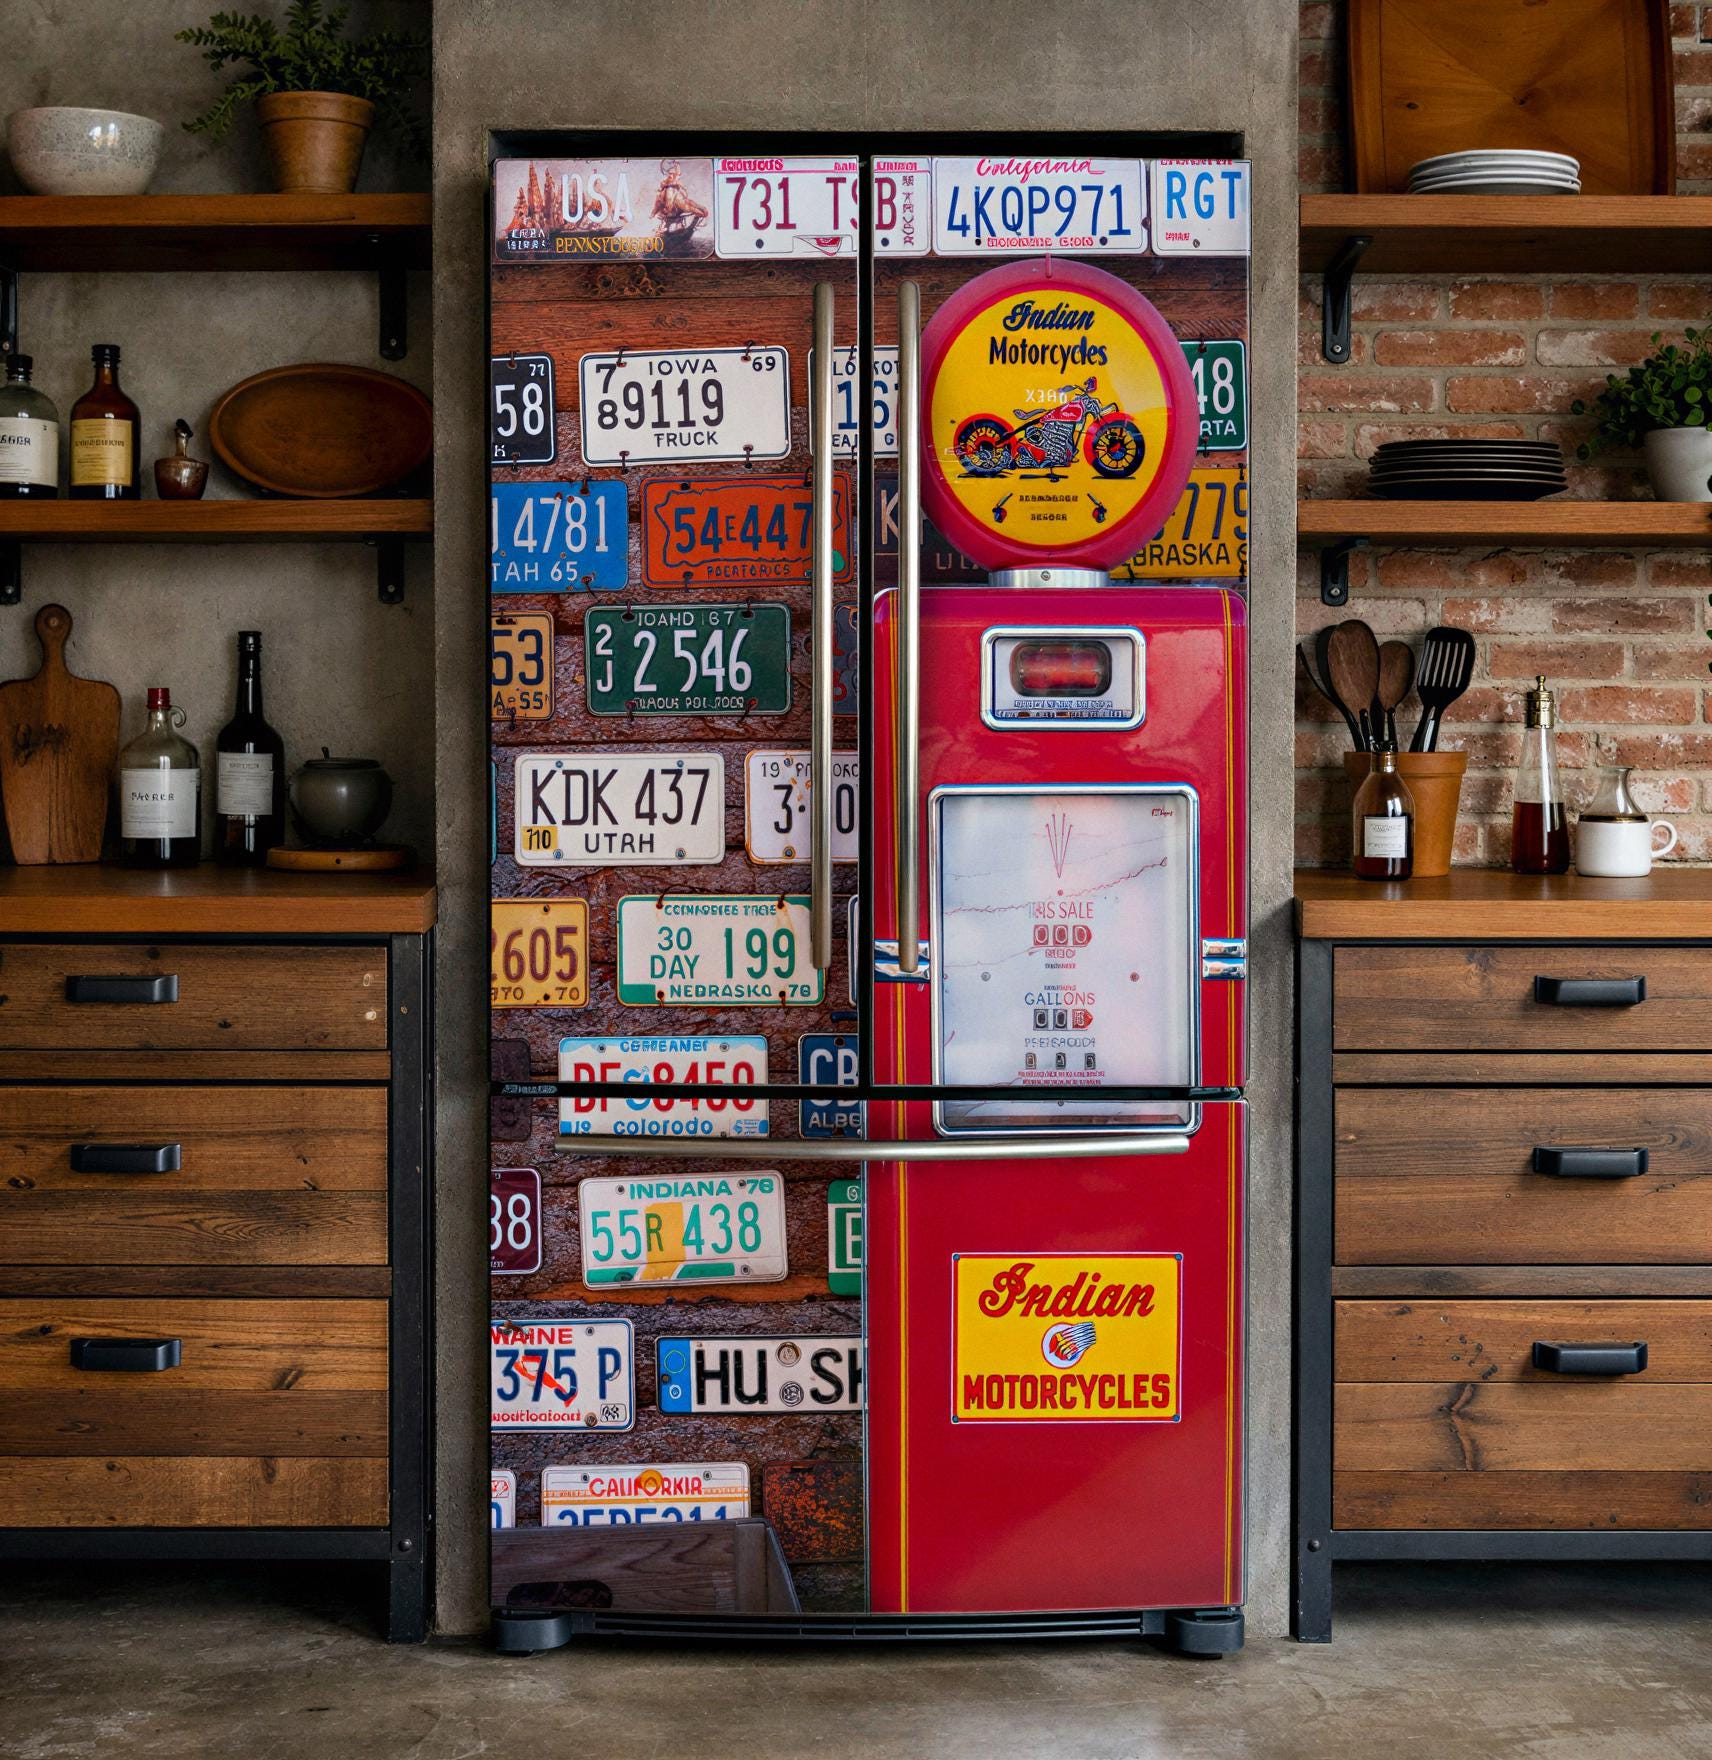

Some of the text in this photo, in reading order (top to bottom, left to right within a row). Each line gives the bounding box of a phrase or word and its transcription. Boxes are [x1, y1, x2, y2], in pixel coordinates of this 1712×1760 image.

[562, 171, 634, 223] USA
[726, 177, 797, 230] 731
[947, 184, 1131, 238] 4KQP971
[1166, 171, 1242, 220] RGT
[1003, 301, 1095, 331] Indian
[648, 356, 776, 376] IOWA 69
[989, 336, 1108, 374] Motorcycles
[495, 383, 545, 436] 58
[1192, 357, 1235, 415] 48
[653, 430, 719, 448] TRUCK
[513, 495, 609, 553] 4781
[550, 561, 579, 582] 65
[492, 629, 544, 685] 53
[531, 769, 711, 826] KDK 437
[1058, 901, 1095, 919] SALE
[657, 926, 692, 951] 30
[724, 927, 795, 980] 199
[650, 954, 700, 979] DAY
[1024, 991, 1096, 1006] GALLONS
[629, 1180, 733, 1200] INDIANA
[978, 1262, 1155, 1318] Indian
[496, 1347, 622, 1402] 375 P
[695, 1349, 768, 1405] HU
[963, 1373, 1171, 1410] MOTORCYCLES
